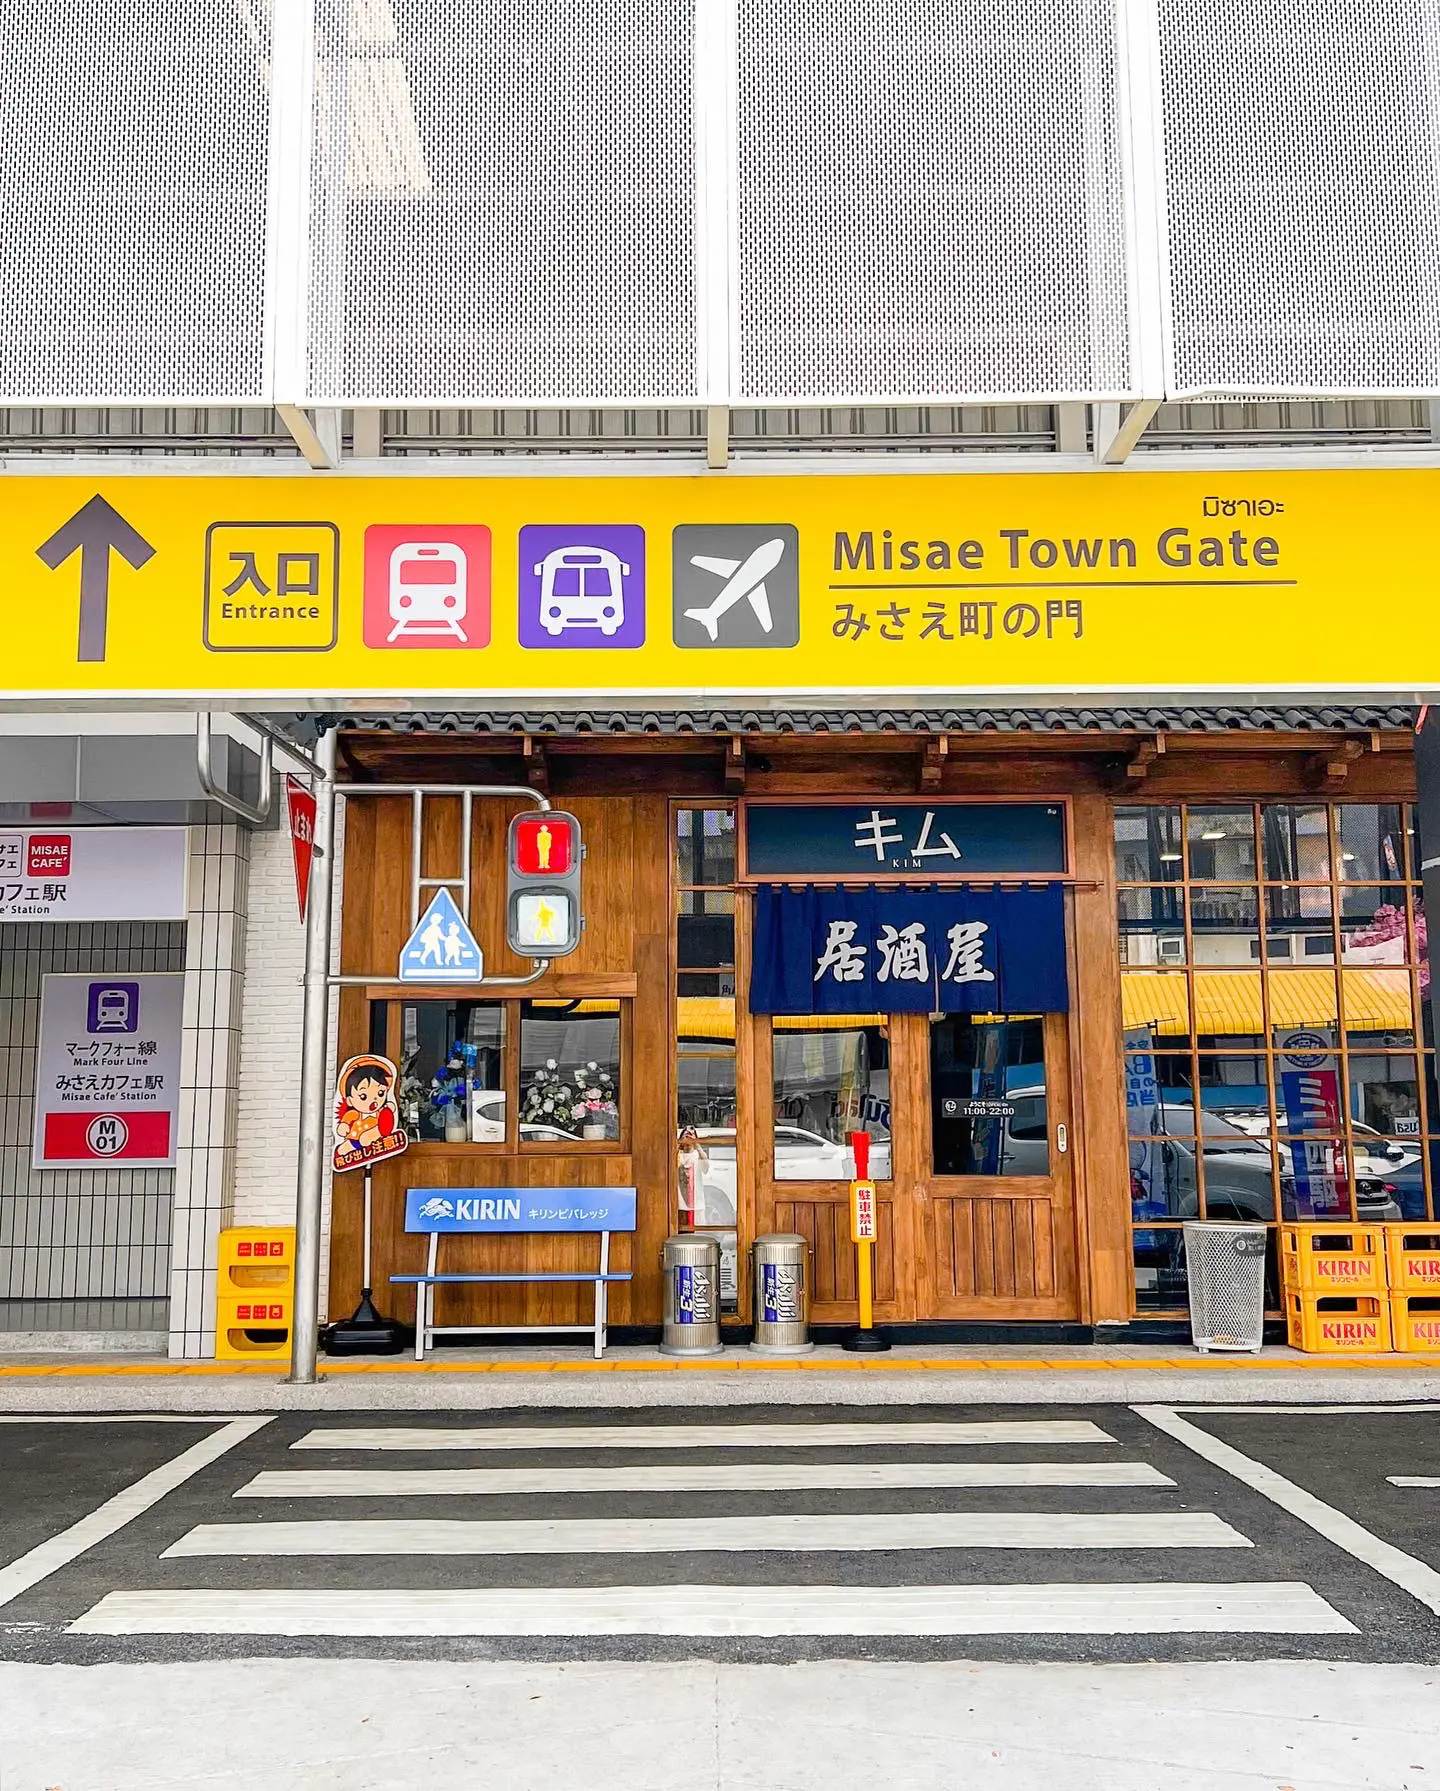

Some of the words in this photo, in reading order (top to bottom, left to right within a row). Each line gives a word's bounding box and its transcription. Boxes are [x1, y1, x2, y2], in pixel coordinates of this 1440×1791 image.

[833, 529, 984, 571] Misae
[1000, 529, 1137, 569] Town
[1158, 527, 1280, 567] Gate
[222, 552, 320, 596] 入口
[222, 603, 320, 619] Entrance
[832, 599, 1084, 641] みさえ町の門
[854, 810, 962, 861] キム
[31, 845, 68, 855] MISAE
[893, 859, 922, 868] KIM
[0, 884, 66, 902] フェ駅
[11, 905, 50, 914] Station
[813, 920, 996, 984] 居酒屋
[66, 1041, 157, 1056] マークフォー線
[73, 1058, 99, 1066] Mark
[101, 1058, 124, 1066] Four
[127, 1057, 148, 1065] Line
[56, 1074, 164, 1091] みさえカフェ駅
[62, 1092, 91, 1101] Misae
[120, 1091, 157, 1101] Station
[963, 1107, 1015, 1115] 11:00-22:00
[99, 1120, 116, 1135] M
[96, 1136, 117, 1150] 01
[456, 1199, 521, 1221] KIRIN
[858, 1189, 872, 1236] 駐車禁止
[1317, 1260, 1371, 1276] KIRIN
[694, 1270, 712, 1320] Asahi
[777, 1269, 797, 1318] Asahi
[1322, 1323, 1377, 1339] KIRIN
